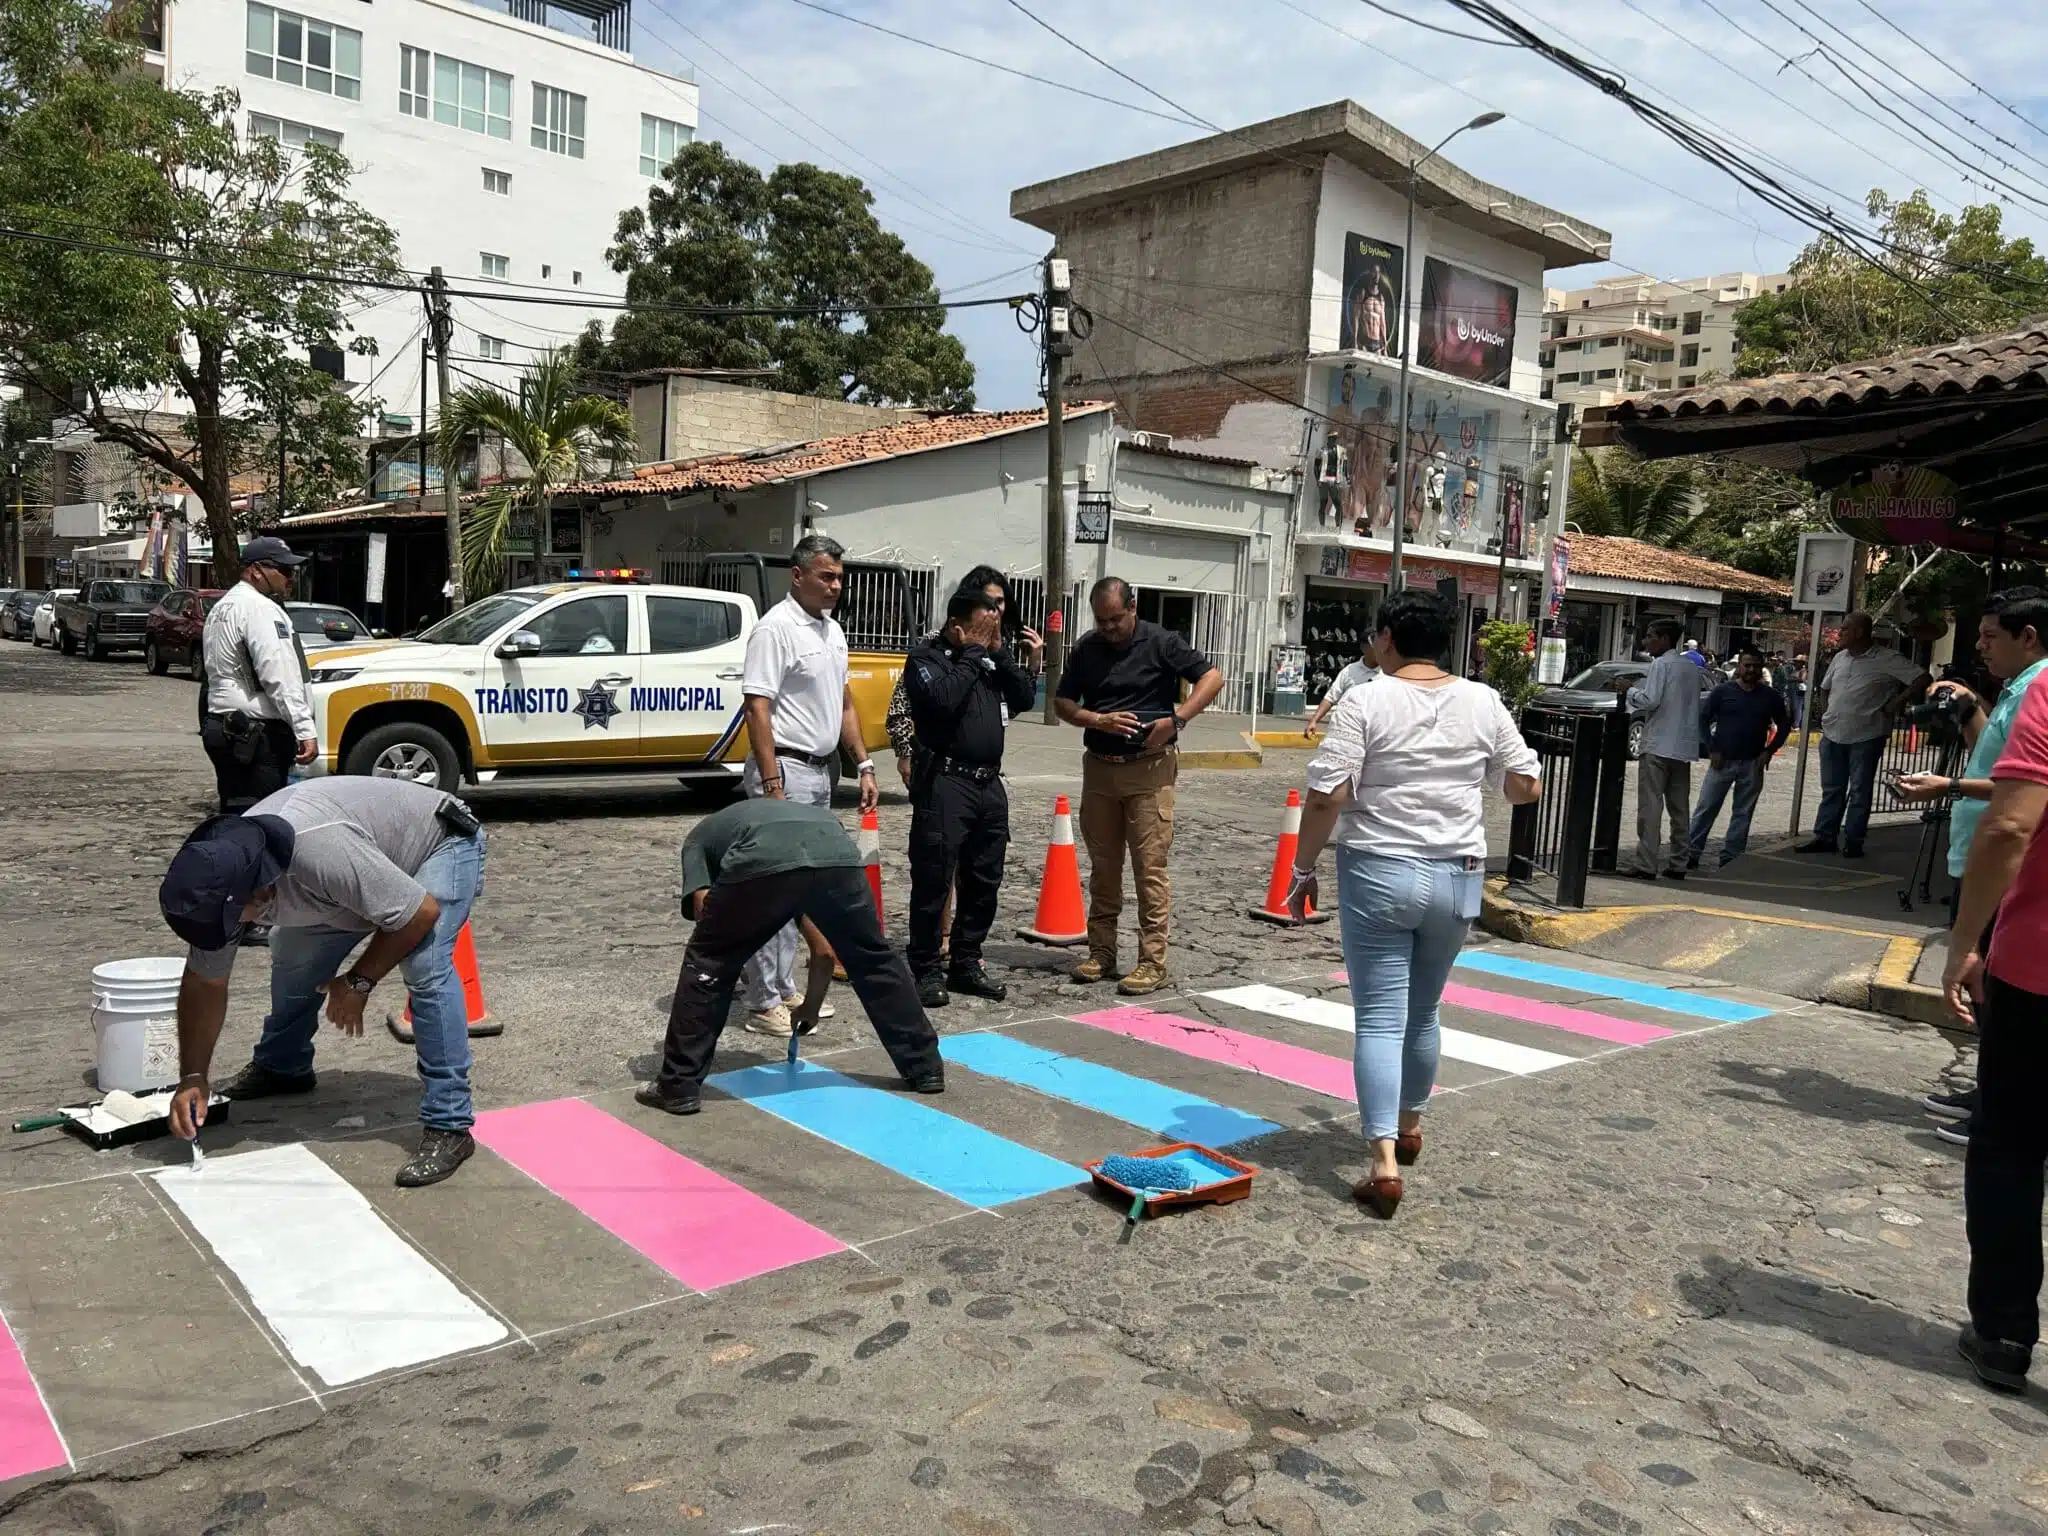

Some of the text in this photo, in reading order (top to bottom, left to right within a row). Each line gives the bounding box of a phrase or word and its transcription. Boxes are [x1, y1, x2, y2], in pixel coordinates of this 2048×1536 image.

[1368, 245, 1392, 259] byUnder
[1471, 323, 1505, 348] byUnder
[1864, 497, 1956, 518] FLAMINGO
[391, 683, 430, 700] PT-287
[475, 683, 725, 714] TRÁNSITO MUNICIPAL
